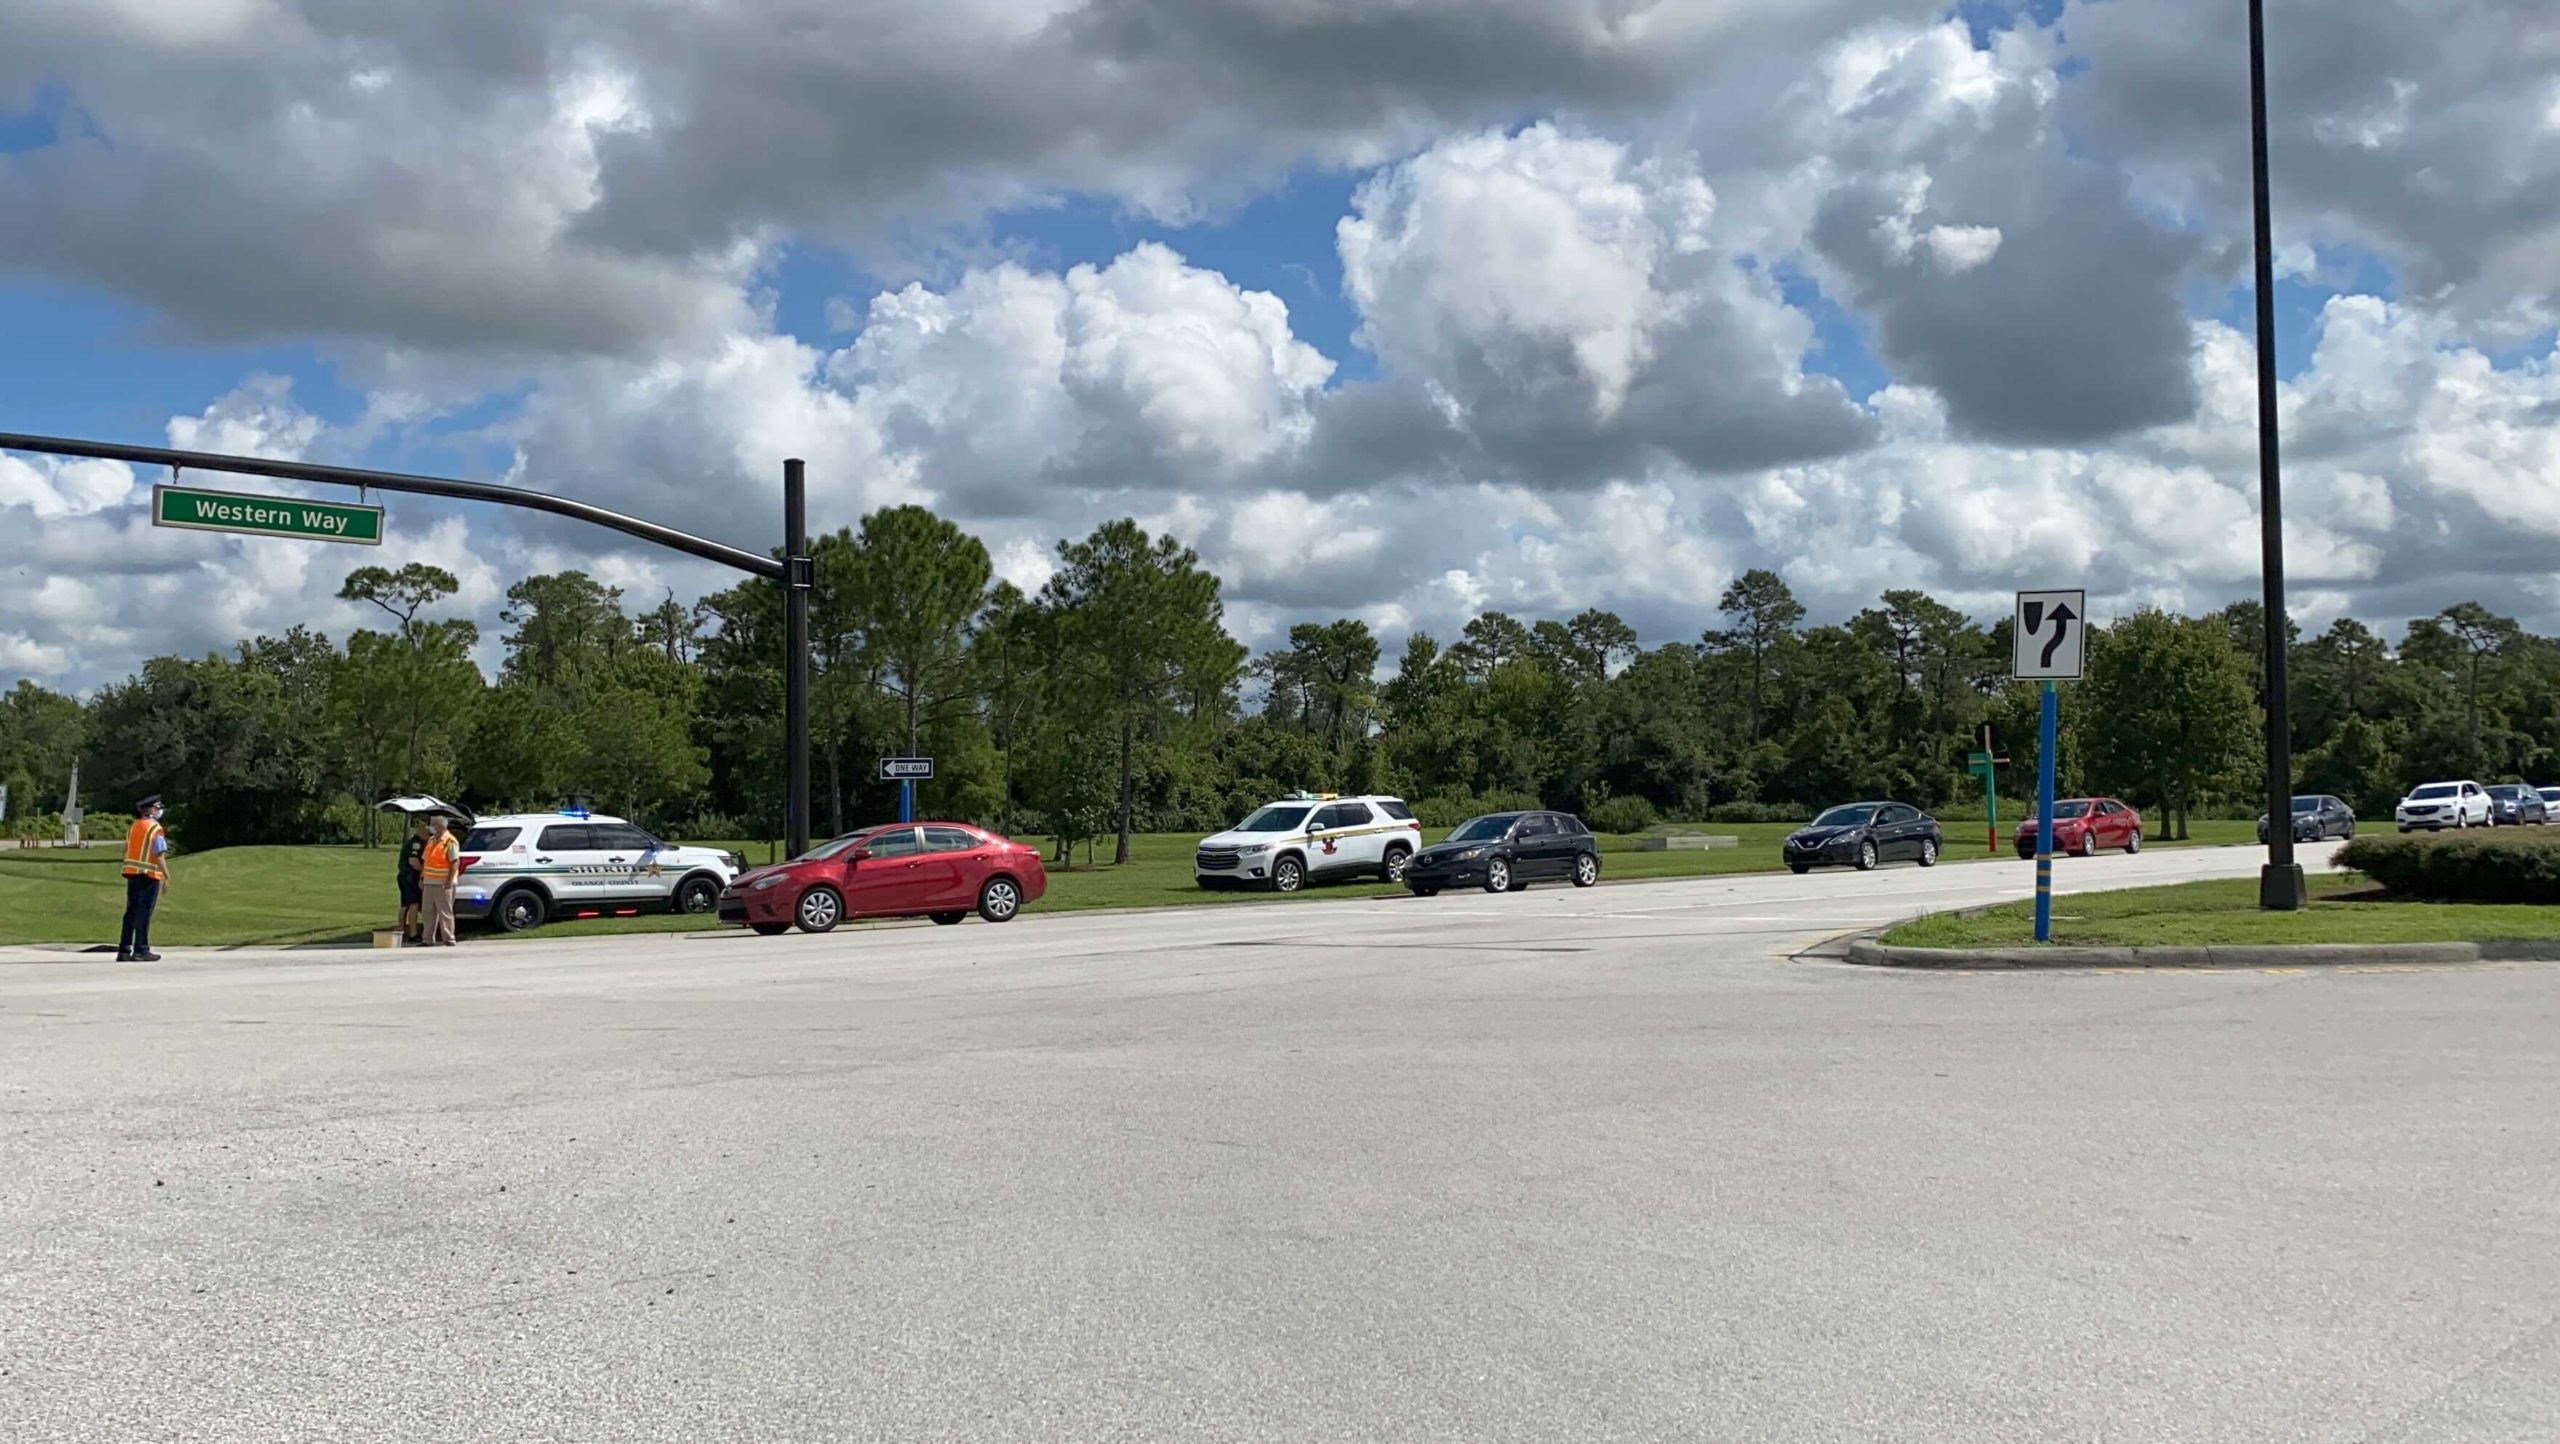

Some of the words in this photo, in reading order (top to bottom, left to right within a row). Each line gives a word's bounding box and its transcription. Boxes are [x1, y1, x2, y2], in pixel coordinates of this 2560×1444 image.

[196, 500, 291, 525] Western
[303, 511, 348, 534] Way
[895, 764, 910, 772] ONE
[912, 764, 927, 772] WAY
[568, 865, 641, 874] SHERIFF
